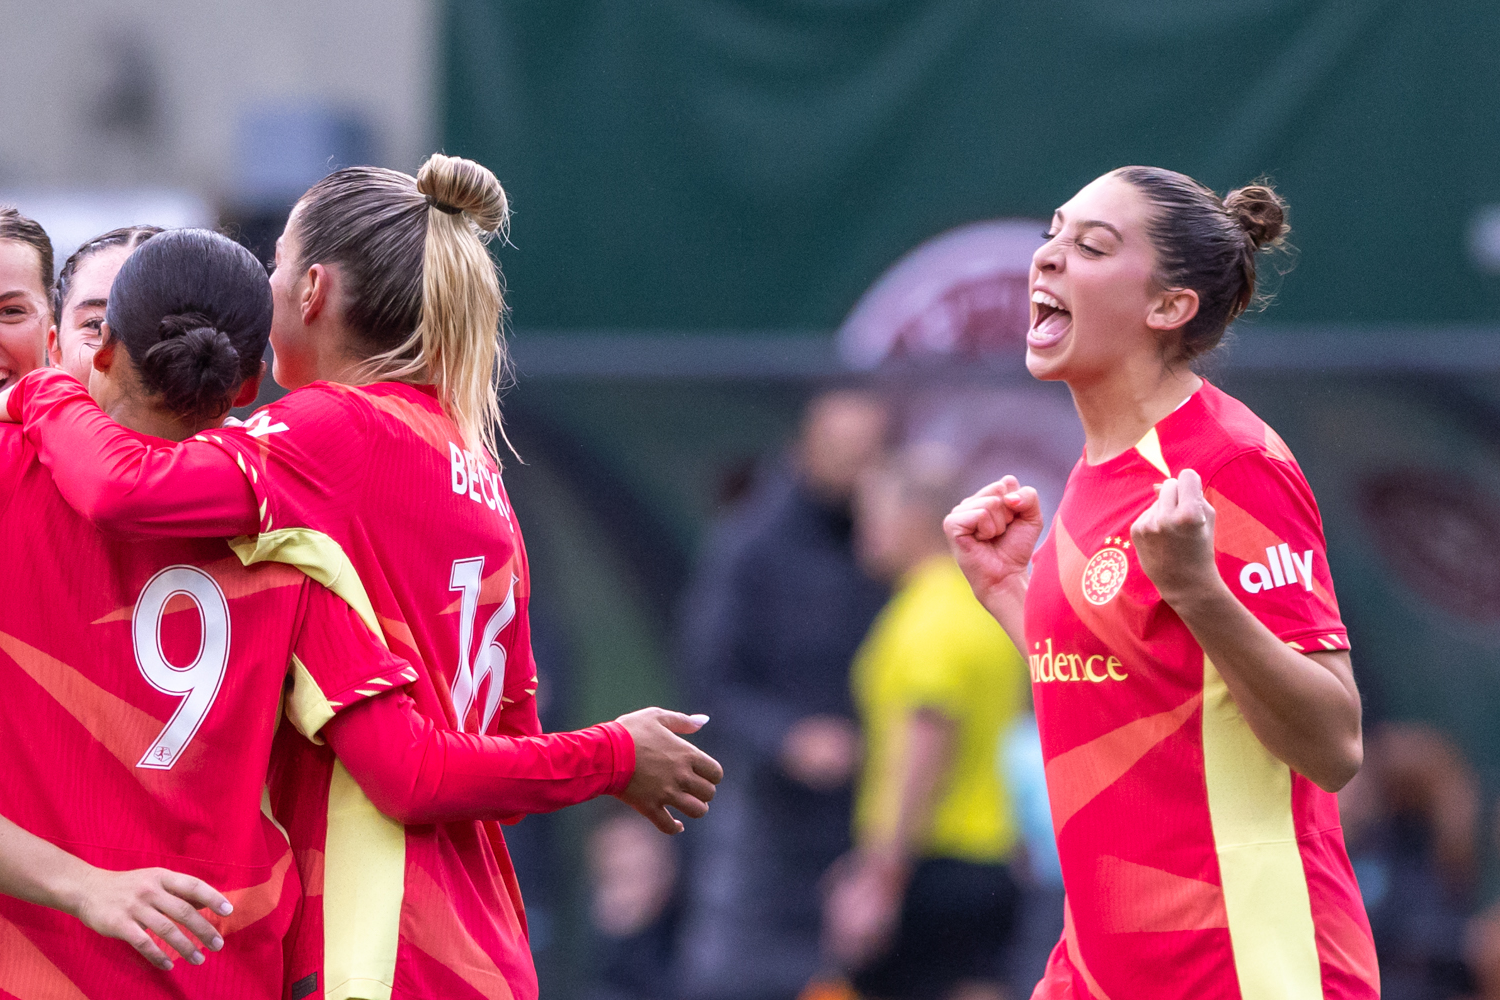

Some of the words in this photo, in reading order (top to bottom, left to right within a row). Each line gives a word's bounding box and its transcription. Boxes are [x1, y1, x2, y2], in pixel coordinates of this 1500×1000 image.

[448, 441, 515, 533] BECK
[1239, 543, 1314, 594] ally
[131, 563, 232, 770] 9
[449, 556, 520, 736] 16
